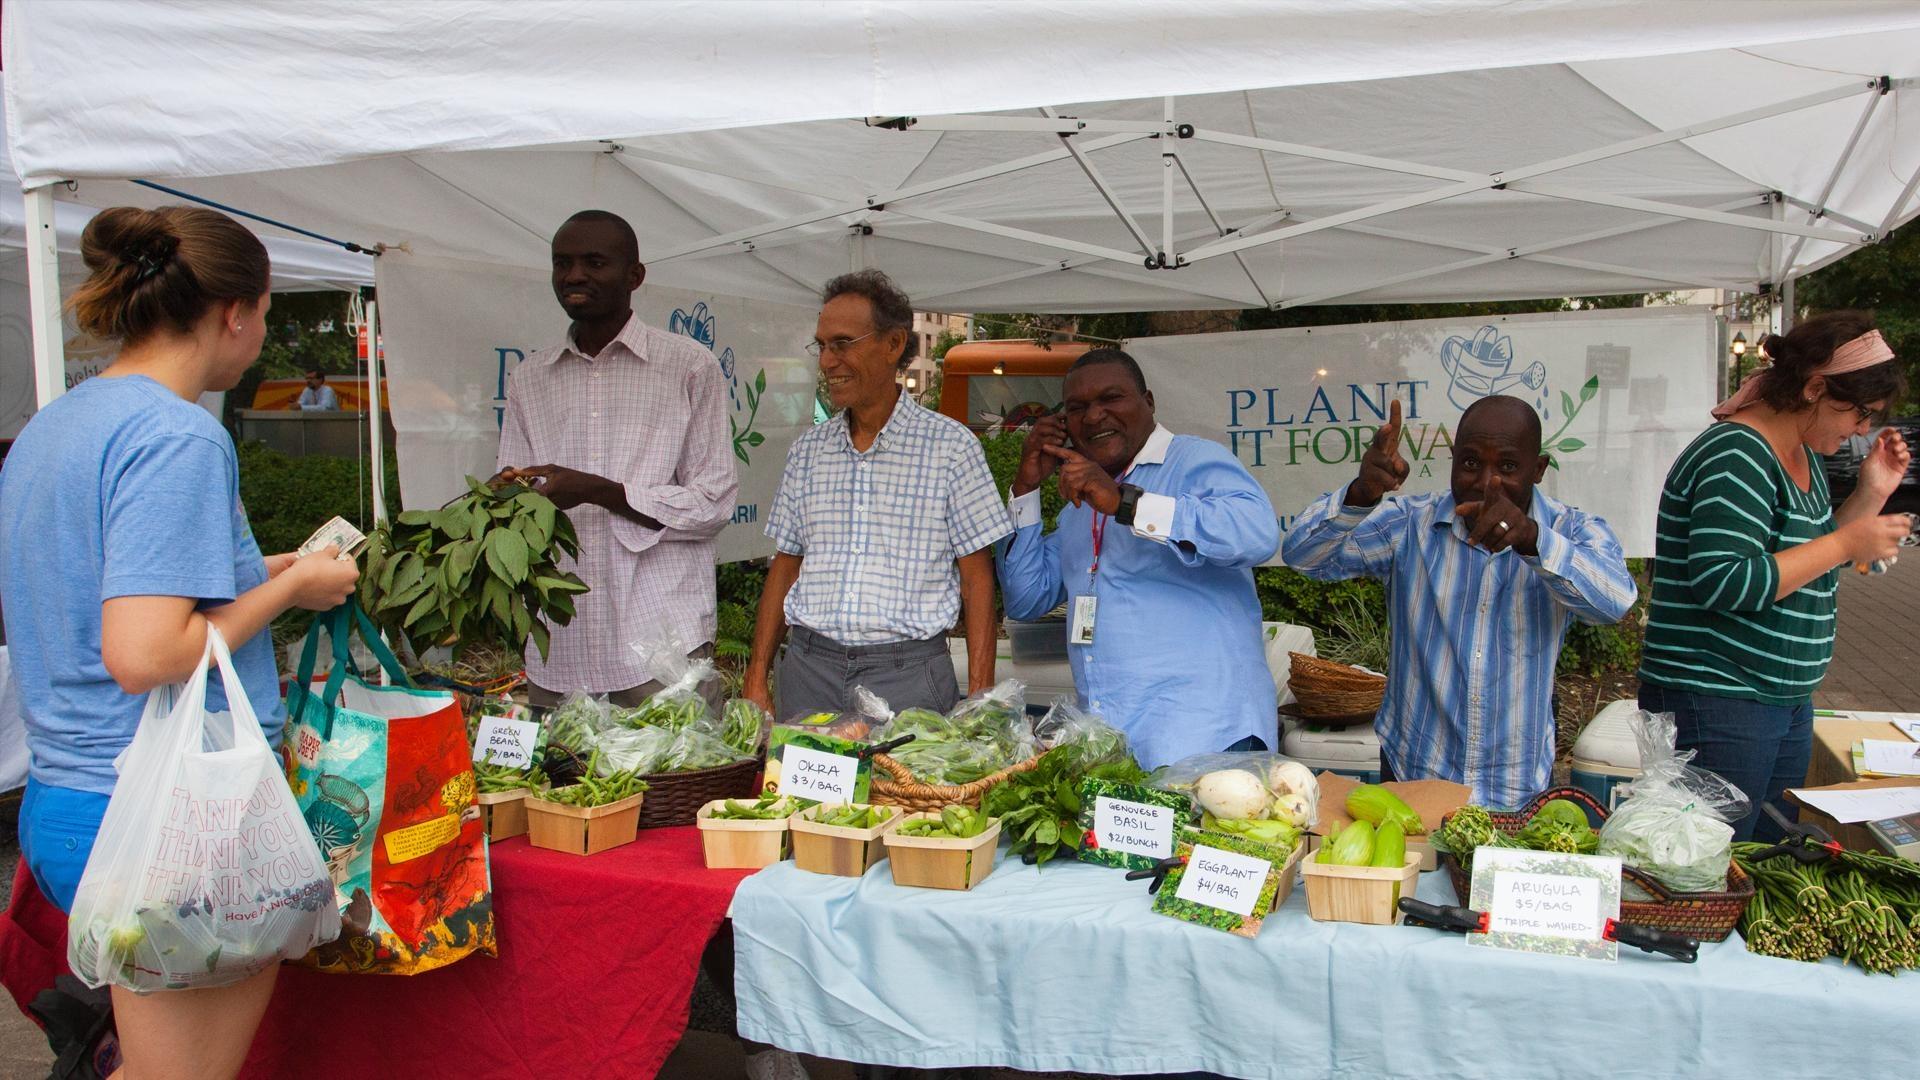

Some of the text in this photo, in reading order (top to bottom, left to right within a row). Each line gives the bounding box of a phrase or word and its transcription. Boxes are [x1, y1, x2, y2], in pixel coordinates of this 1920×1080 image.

[1226, 380, 1429, 427] PLANT
[1226, 421, 1455, 467] IT FORWA
[1418, 463, 1433, 478] A
[728, 503, 757, 525] ARM
[492, 726, 521, 737] GREEN
[489, 735, 520, 747] BEANS
[798, 759, 840, 777] OKRA
[1108, 802, 1159, 818] GENOVESE
[1113, 815, 1156, 831] BASIL
[239, 812, 298, 860] YOU
[1108, 832, 1160, 850] $2/BUNCH
[247, 852, 315, 899] YOU
[1198, 860, 1259, 880] EGGPLANT
[1197, 877, 1239, 900] $4/BAG
[1511, 881, 1581, 897] ARUGULA
[225, 908, 258, 922] Have
[259, 904, 271, 915] A
[270, 892, 300, 910] Nice
[1515, 898, 1573, 913] $5/BAG
